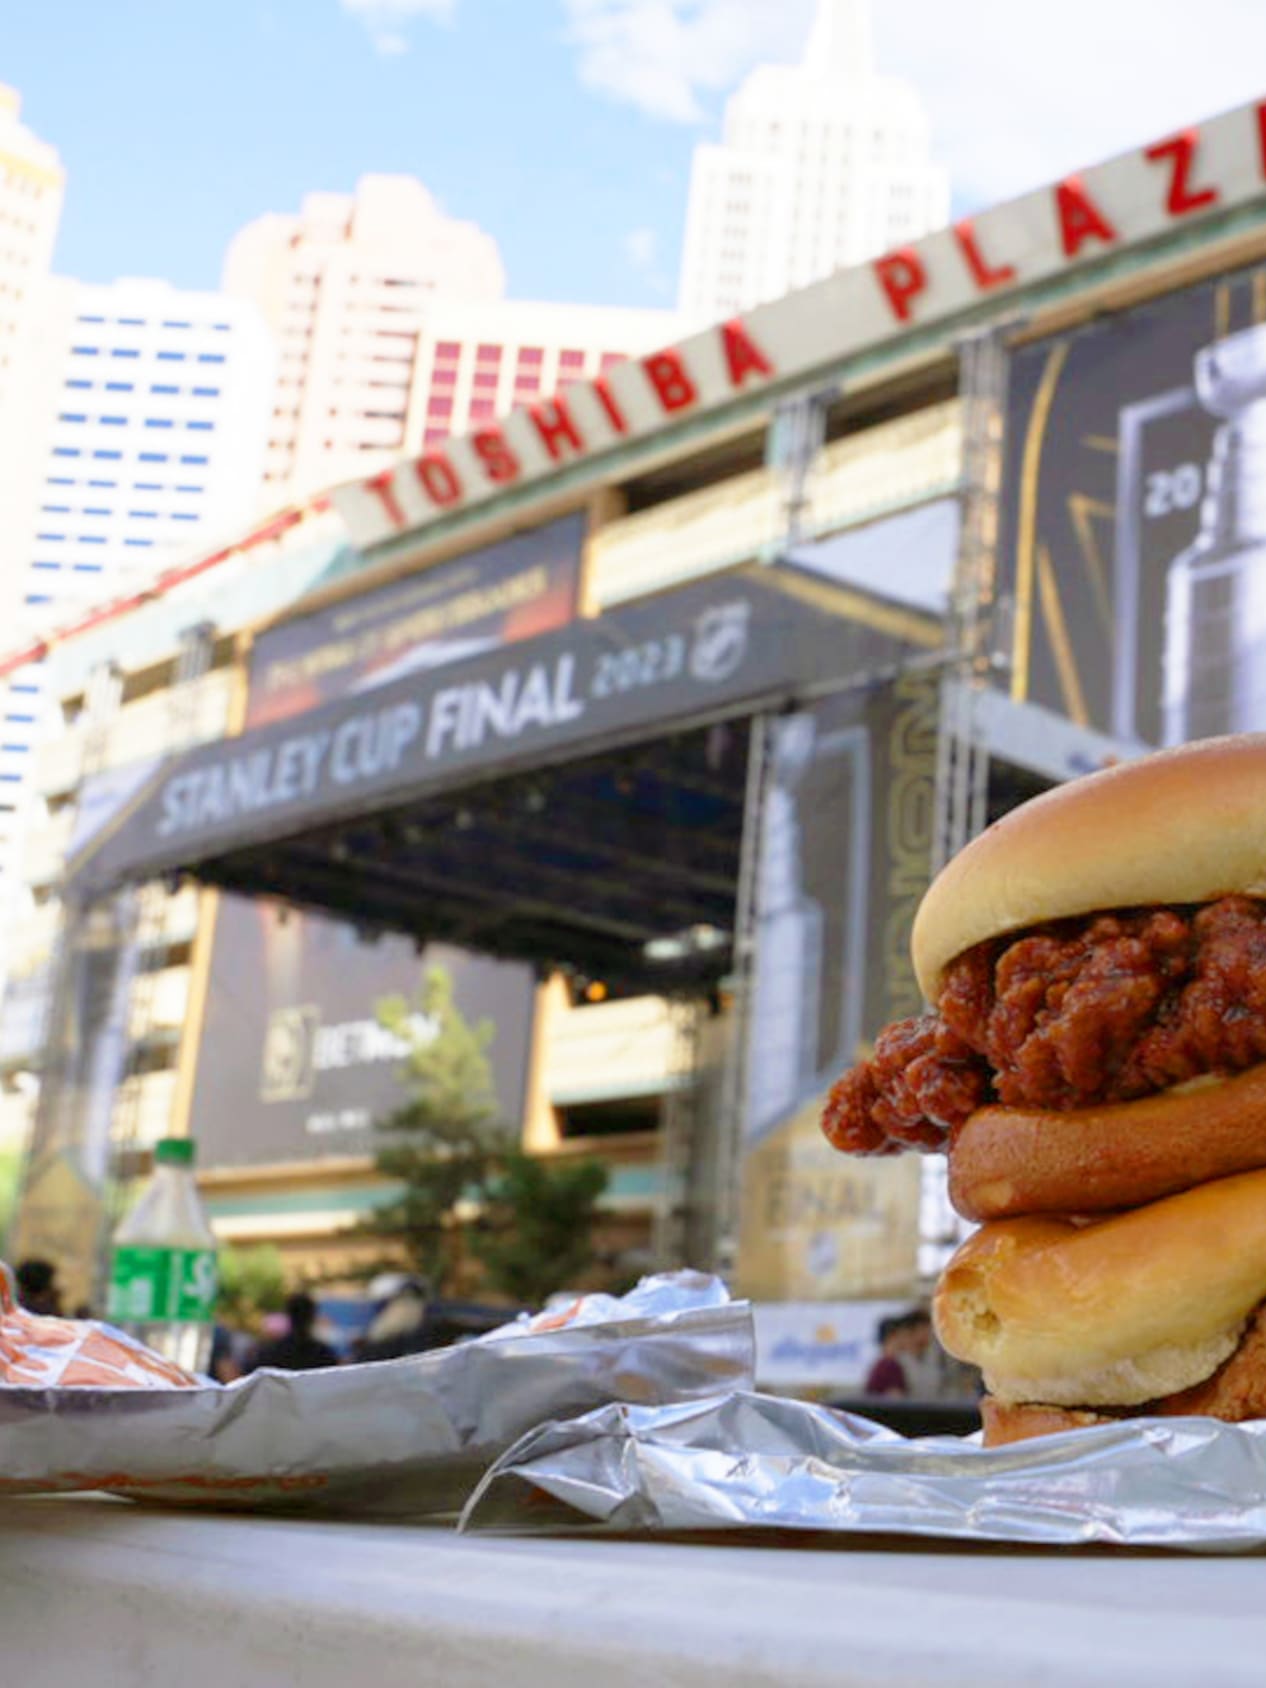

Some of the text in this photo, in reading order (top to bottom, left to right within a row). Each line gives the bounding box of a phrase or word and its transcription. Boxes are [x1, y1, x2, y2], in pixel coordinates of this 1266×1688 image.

[363, 317, 776, 528] TOSHIBA
[1145, 461, 1200, 518] 20
[156, 727, 330, 836] STANLEY
[330, 703, 421, 784] CUP
[425, 652, 585, 759] FINAL
[591, 634, 684, 698] 2023
